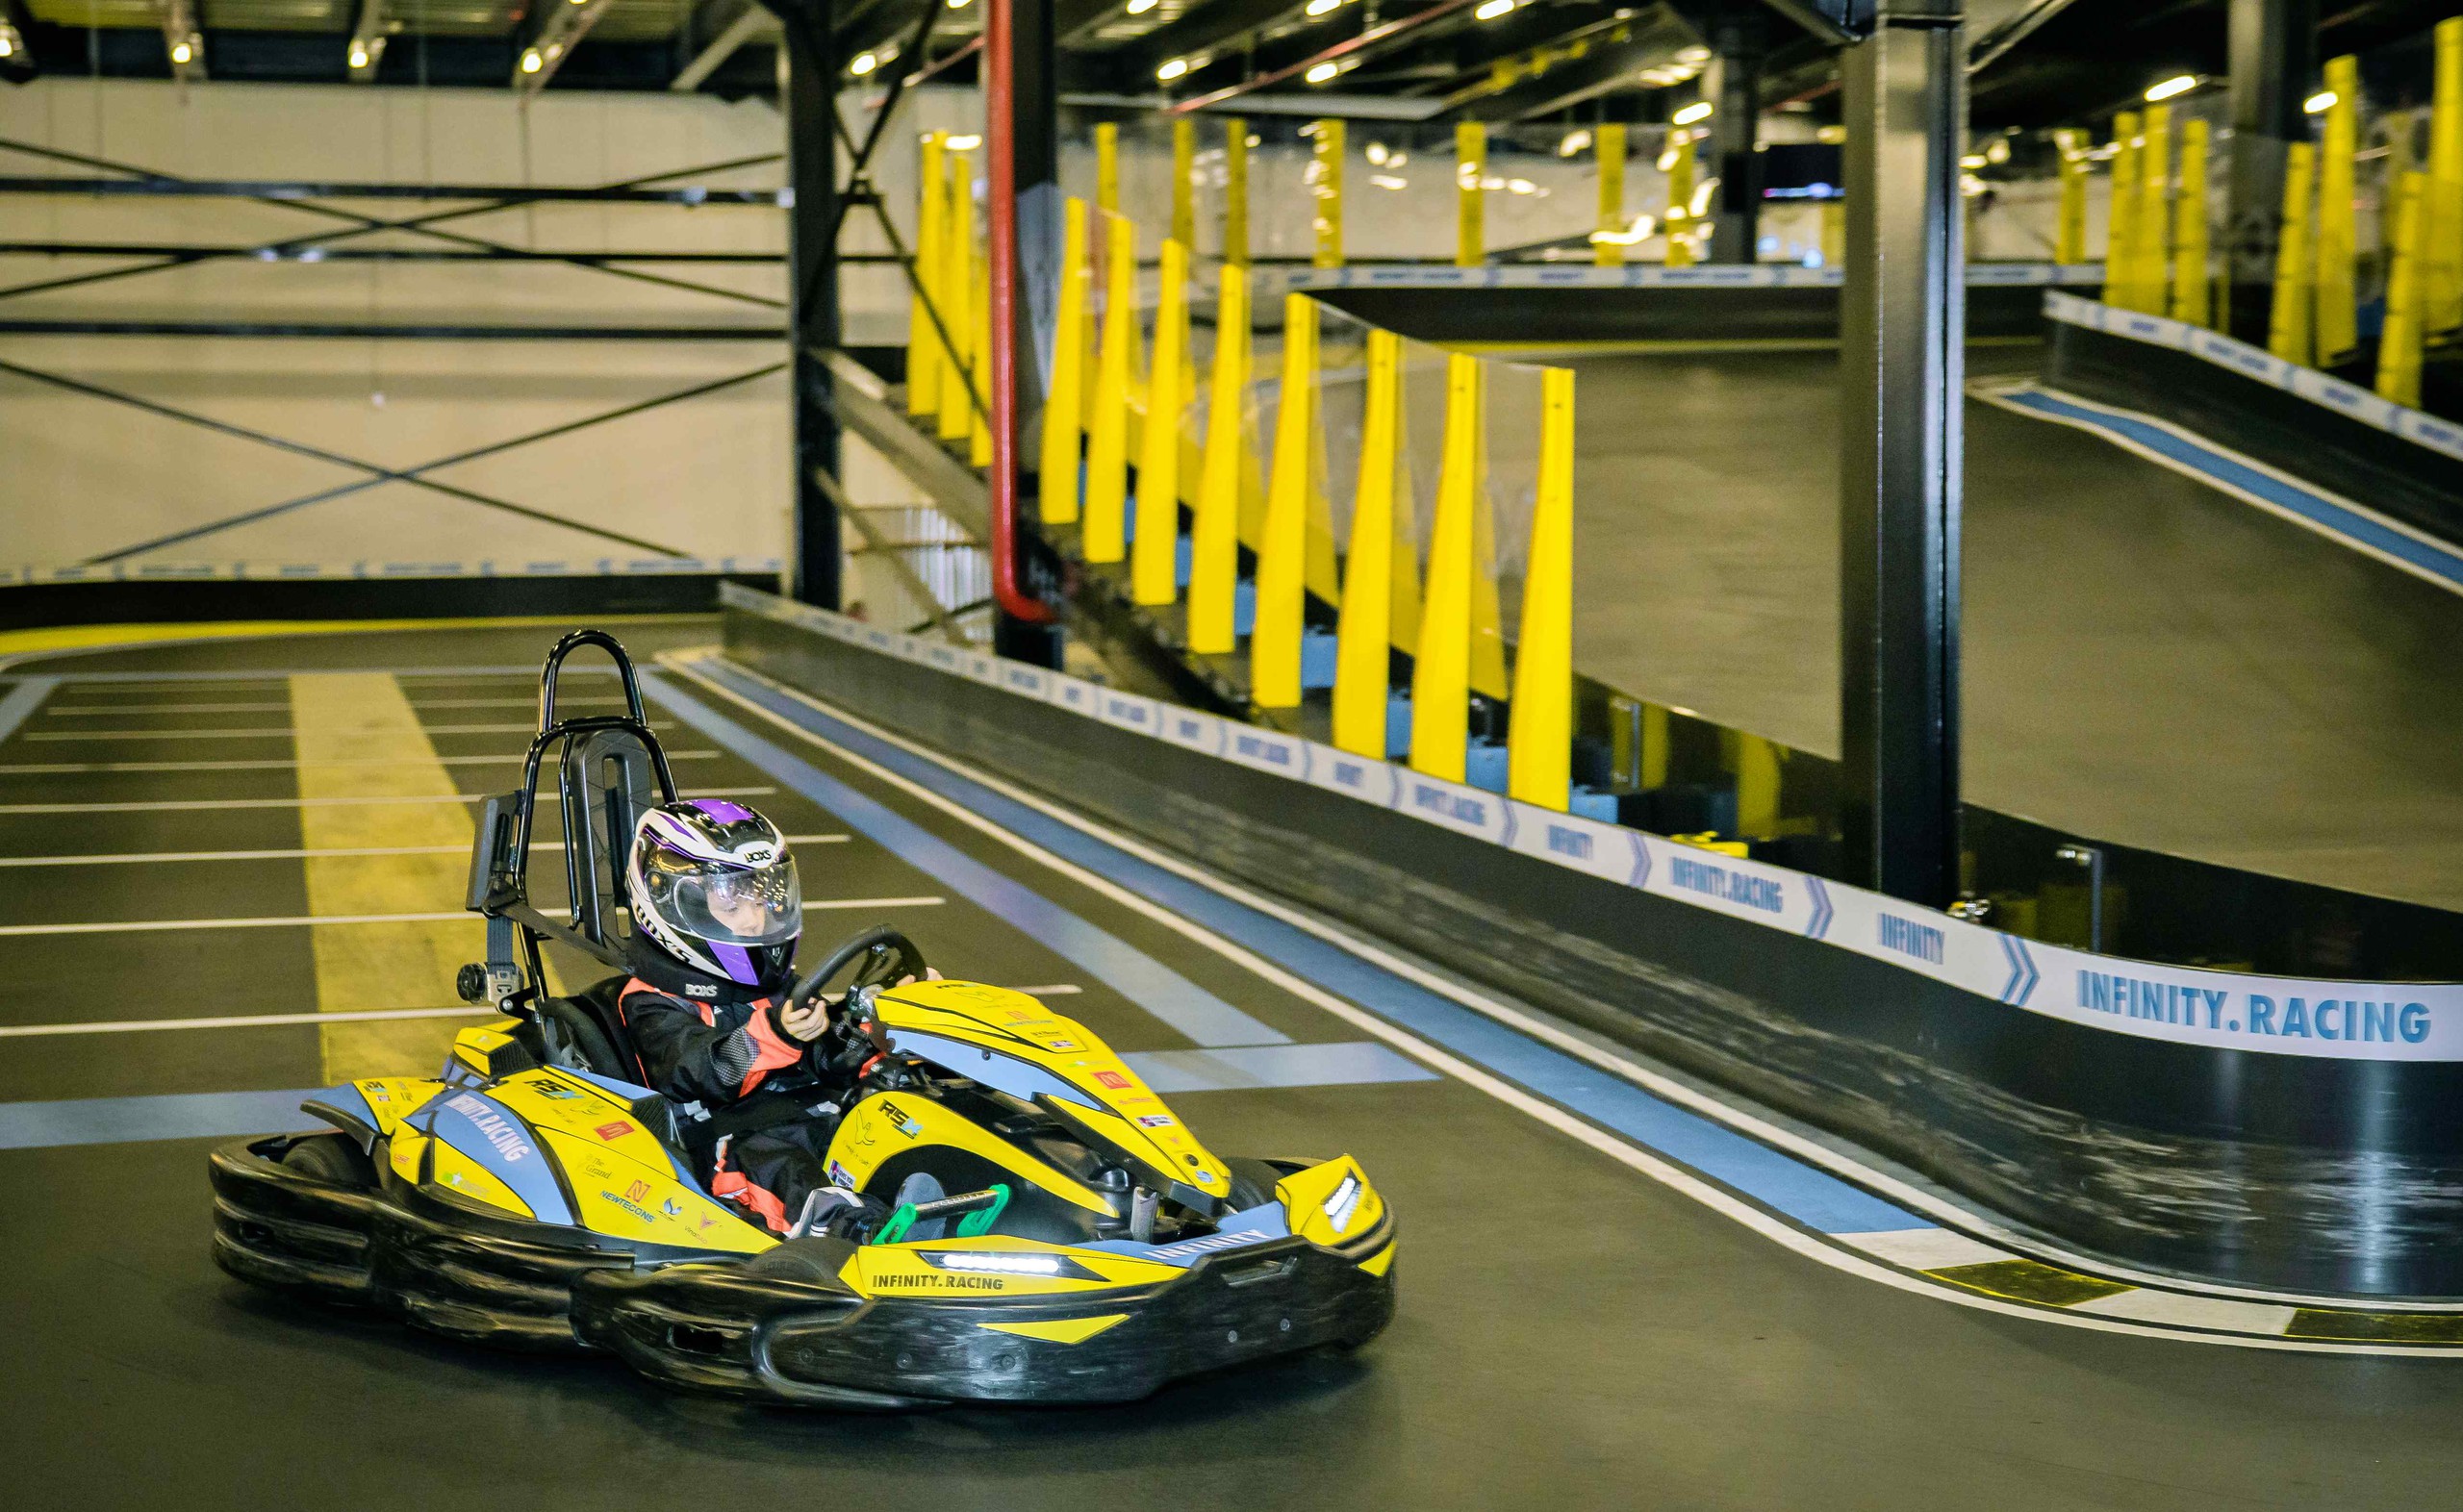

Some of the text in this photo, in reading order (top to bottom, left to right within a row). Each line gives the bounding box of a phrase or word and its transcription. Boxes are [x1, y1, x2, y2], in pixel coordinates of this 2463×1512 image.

[1880, 912, 1945, 966] INFINITY
[2076, 968, 2433, 1045] INFINITY.RACING
[600, 1190, 656, 1223] NEWTECONS
[1142, 1229, 1272, 1260] INFINITY
[872, 1274, 1003, 1290] INFINITY.RACING
